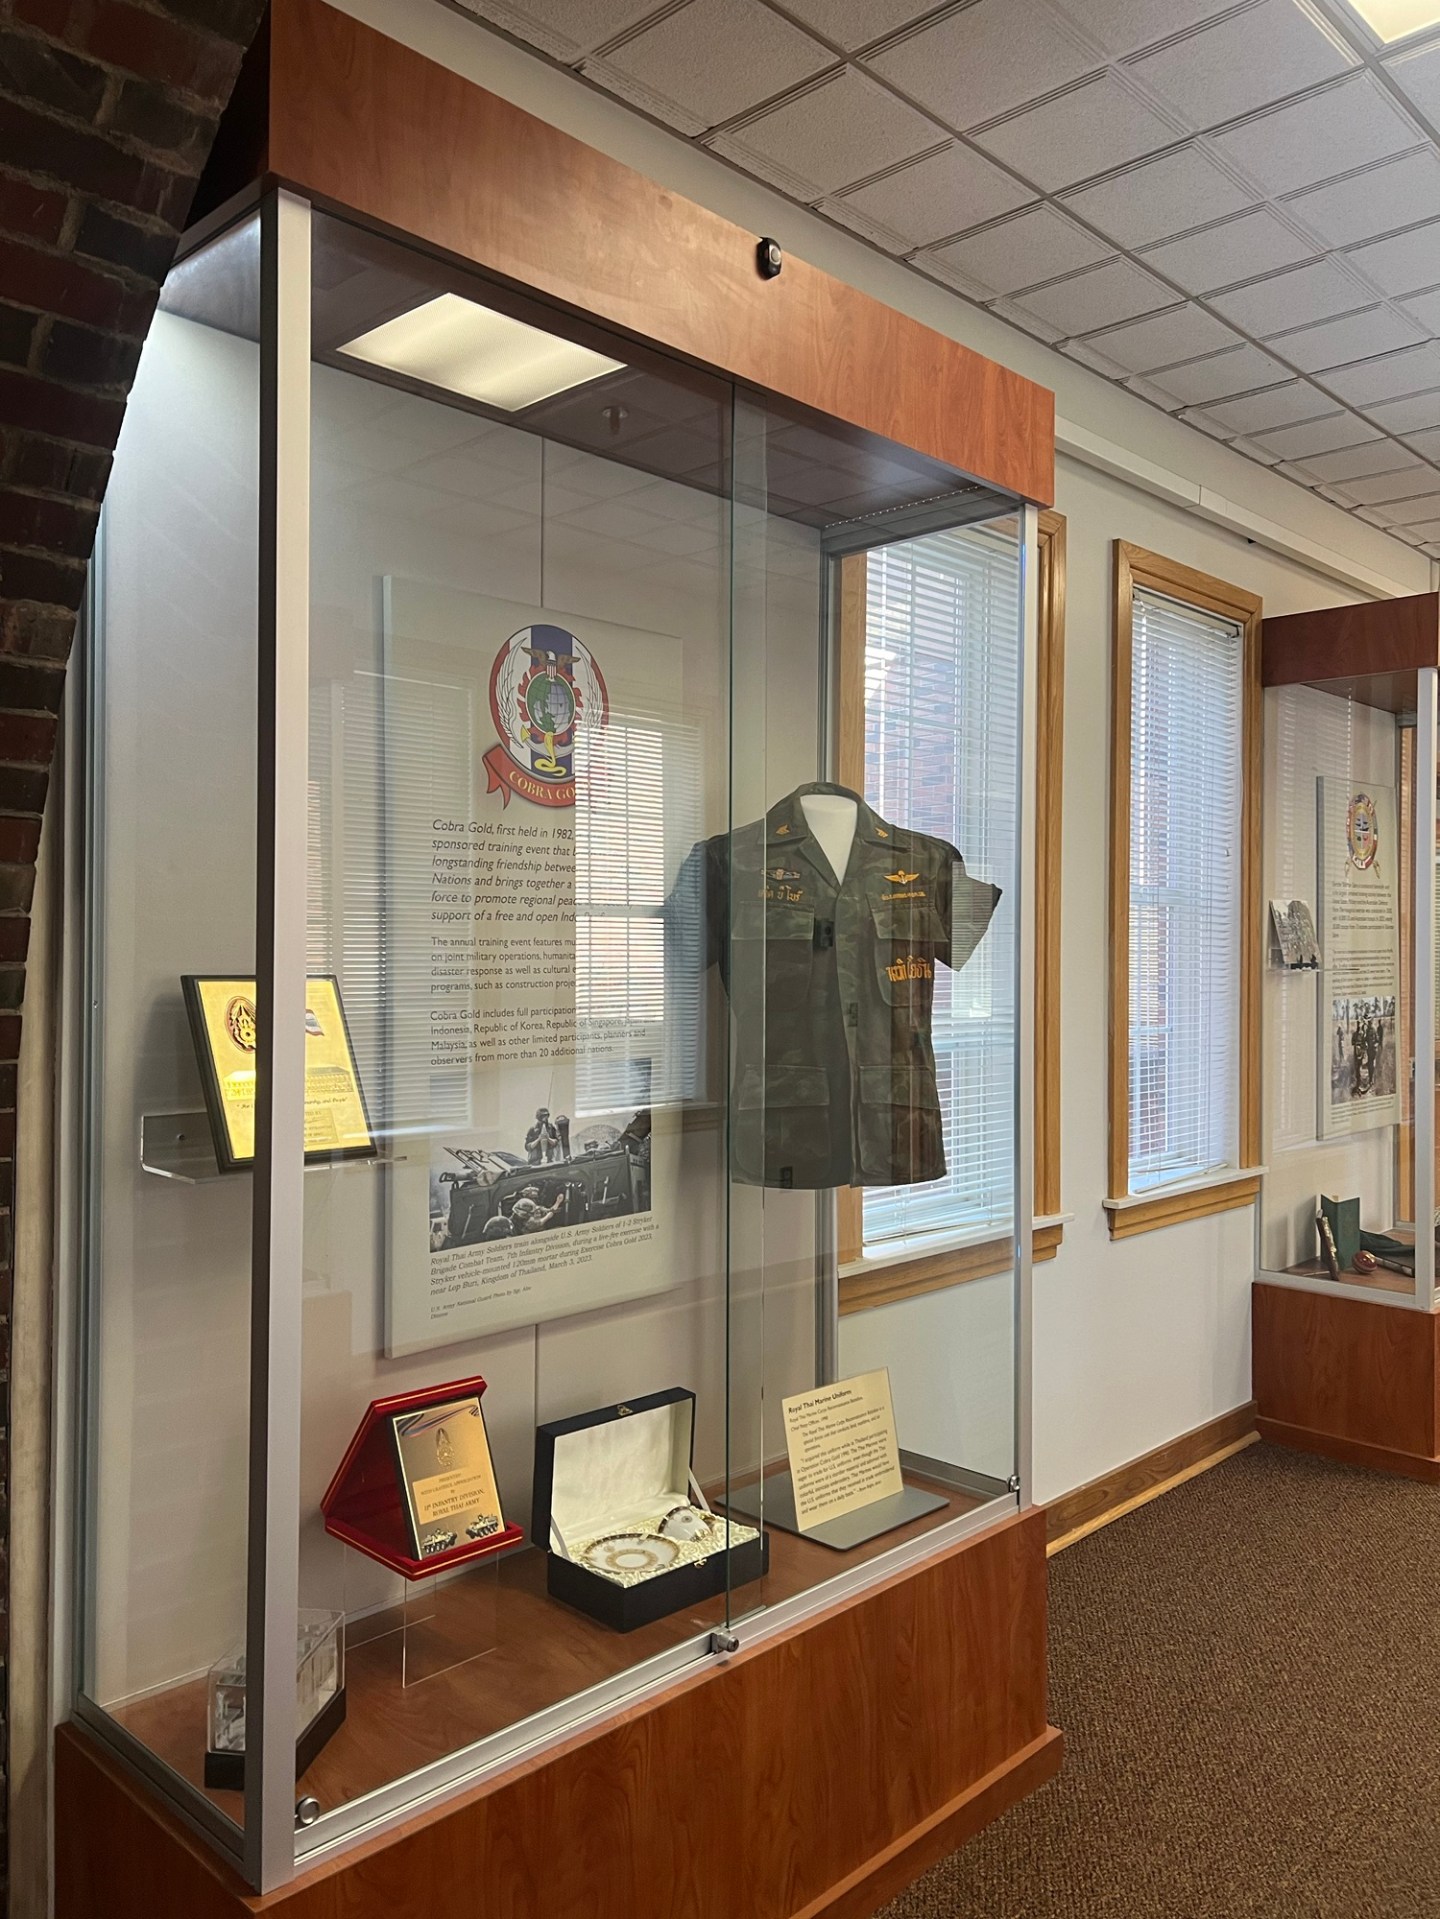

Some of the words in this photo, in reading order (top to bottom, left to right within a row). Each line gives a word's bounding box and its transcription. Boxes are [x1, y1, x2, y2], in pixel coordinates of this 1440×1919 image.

[510, 770, 552, 799] COBRA
[433, 819, 464, 832] Cobra
[469, 822, 494, 835] Gold,
[497, 824, 515, 835] first
[518, 826, 538, 837] held
[540, 828, 548, 838] in
[553, 828, 574, 840] 1982,
[432, 840, 485, 851] sponsored
[488, 842, 523, 856] training
[526, 846, 550, 855] event
[553, 845, 570, 856] that
[432, 855, 494, 871] longstanding
[496, 859, 542, 874] friendship
[545, 861, 577, 872] betwee
[432, 873, 471, 884] Nations
[475, 875, 493, 886] and
[495, 876, 523, 890] brings
[526, 878, 565, 890] together
[567, 881, 572, 889] a
[432, 891, 458, 902] force
[474, 896, 517, 906] promote
[520, 895, 556, 907] regional
[557, 898, 578, 908] peac
[431, 912, 471, 923] support
[474, 910, 486, 920] of
[495, 910, 514, 920] free
[516, 911, 534, 920] and
[536, 914, 558, 924] open
[431, 937, 448, 946] The
[450, 937, 476, 946] annual
[479, 938, 508, 948] training
[534, 937, 562, 946] features
[444, 953, 464, 963] joint
[466, 952, 496, 963] military
[499, 952, 541, 963] operations,
[543, 951, 576, 960] humanita
[431, 967, 464, 975] disaster
[466, 968, 502, 977] response
[515, 965, 530, 974] well
[543, 965, 570, 973] cultural
[431, 983, 472, 993] programs,
[474, 980, 492, 989] such
[506, 980, 553, 989] construction
[430, 1011, 457, 1020] Cobra
[460, 1010, 480, 1019] Gold
[483, 1008, 515, 1018] includes
[517, 1008, 528, 1016] full
[531, 1006, 576, 1018] participation
[431, 1025, 472, 1034] Indonesia,
[474, 1023, 507, 1034] Republic
[510, 1021, 518, 1031] of
[520, 1021, 545, 1030] Korea,
[546, 1019, 576, 1030] Republic
[579, 1018, 587, 1027] of
[432, 1041, 467, 1052] Malaysia,
[480, 1038, 496, 1046] well
[509, 1036, 530, 1045] other
[533, 1034, 557, 1043] limited
[560, 1032, 602, 1044] participants,
[604, 1031, 632, 1041] planners
[634, 1028, 646, 1037] and
[431, 1056, 472, 1065] observers
[475, 1053, 494, 1062] from
[497, 1052, 518, 1060] more
[521, 1050, 537, 1059] than
[540, 1048, 548, 1057] 20
[551, 1046, 585, 1056] additional
[431, 1255, 450, 1265] Royal
[468, 1250, 485, 1258] Army
[486, 1244, 512, 1254] Soldiers
[531, 1234, 559, 1245] alongside
[560, 1231, 572, 1239] U.S.
[591, 1224, 614, 1233] Soldiers
[633, 1216, 653, 1225] Stryker
[431, 1275, 456, 1285] Stryker
[458, 1262, 511, 1279] vehicle-mounted
[537, 1254, 558, 1262] mortar
[560, 1250, 579, 1258] during
[581, 1244, 604, 1253] Exercise
[624, 1236, 637, 1245] Gold
[431, 1265, 456, 1275] Brigade
[459, 1259, 484, 1269] Combat
[519, 1247, 544, 1256] Infantry
[430, 1288, 446, 1296] near
[448, 1284, 461, 1292] Lop
[481, 1274, 509, 1285] Kingdom
[510, 1270, 517, 1278] of
[518, 1264, 546, 1276] Thailand,
[548, 1260, 567, 1270] March
[788, 1405, 802, 1414] Royal
[803, 1401, 814, 1409] Thai
[815, 1397, 831, 1405] Marine
[832, 1390, 851, 1400] Uniform
[432, 1496, 458, 1509] INFANTRY
[433, 1507, 449, 1516] ROYAL
[450, 1502, 464, 1510] THAI
[466, 1498, 480, 1506] ARMY
